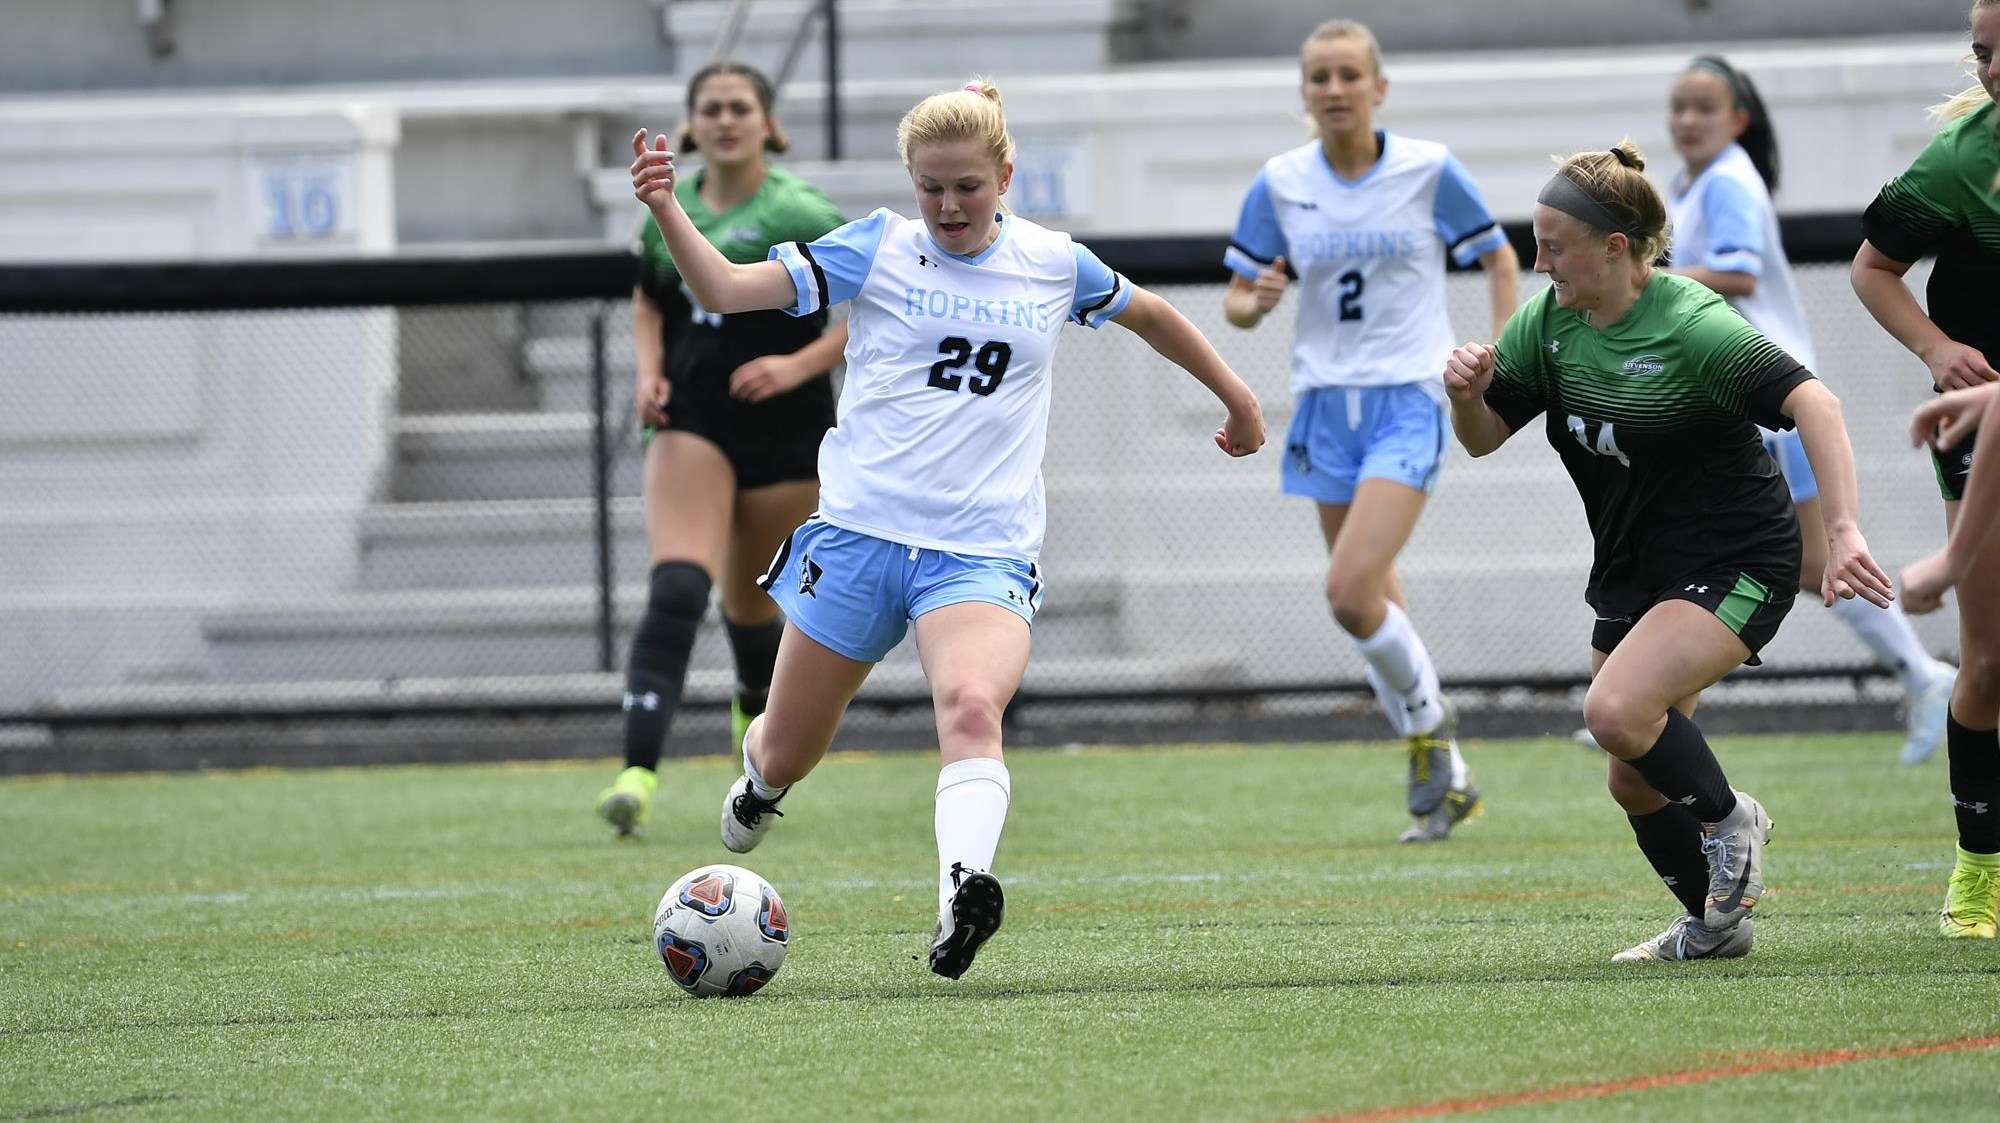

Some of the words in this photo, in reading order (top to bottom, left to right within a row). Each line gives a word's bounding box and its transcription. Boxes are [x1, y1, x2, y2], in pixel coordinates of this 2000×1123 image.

[268, 186, 339, 238] 10
[1296, 229, 1414, 260] HOPKINS
[904, 287, 1050, 333] HOPKINS
[1338, 269, 1364, 322] 2
[927, 335, 1012, 397] 29
[1623, 361, 1665, 371] STEVENSON
